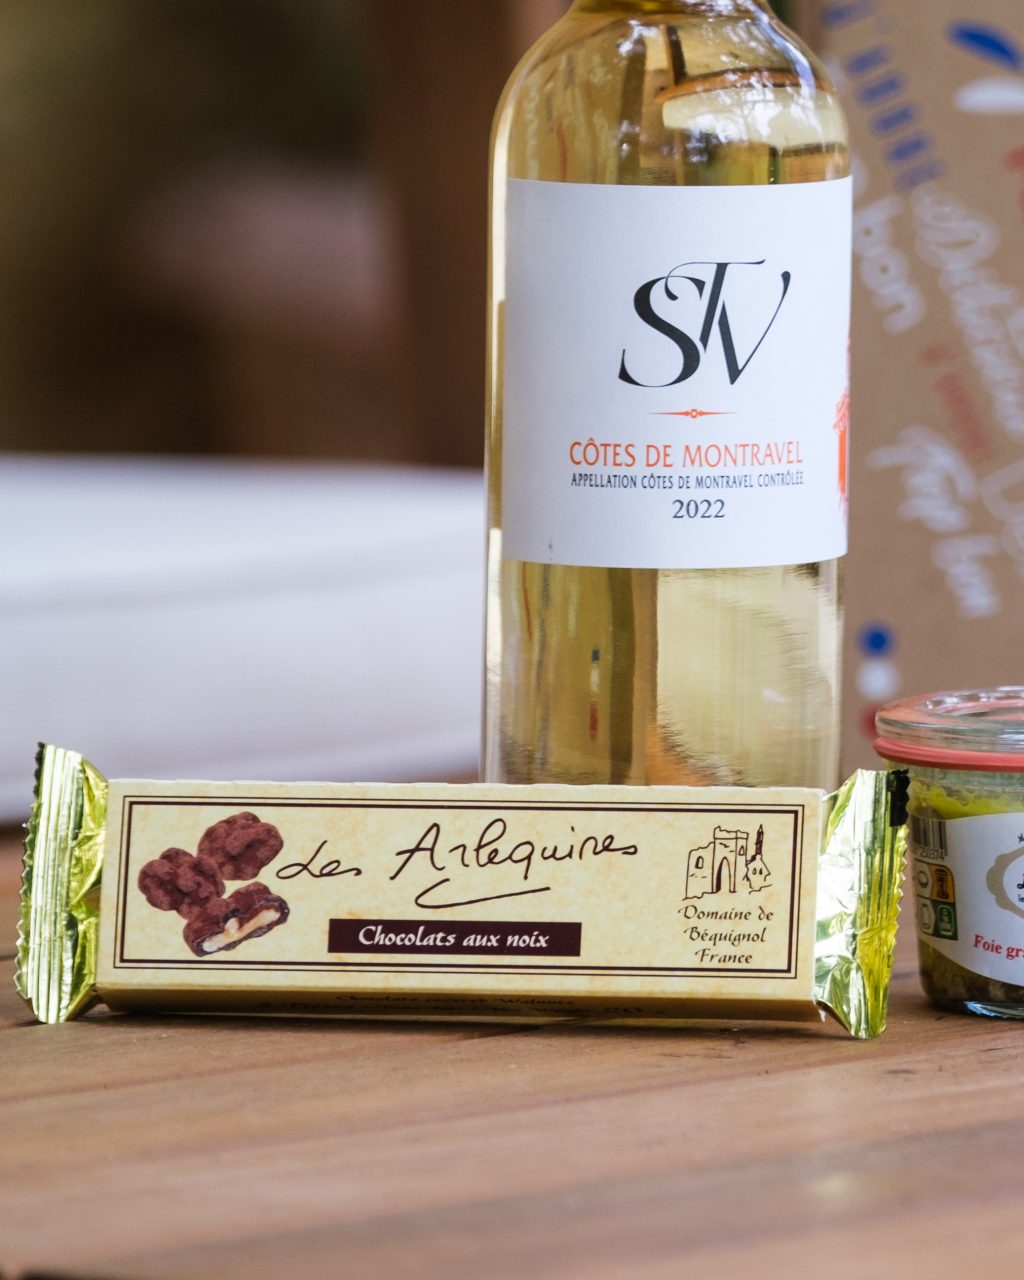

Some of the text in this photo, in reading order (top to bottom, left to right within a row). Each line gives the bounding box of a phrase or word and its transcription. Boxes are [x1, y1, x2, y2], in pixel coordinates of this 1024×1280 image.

[569, 437, 804, 468] CÔTES DE MONTRAVEL
[570, 469, 804, 489] APPELLATION CÔTES DE MONTRAVEL CONTRÔLÉE
[672, 498, 726, 519] 2022
[276, 839, 363, 880] Les
[678, 904, 774, 921] Domaine de
[358, 926, 550, 951] Chocolats aux noix
[683, 926, 767, 947] Béquignol
[973, 934, 1003, 955] Foie
[694, 948, 753, 964] France
